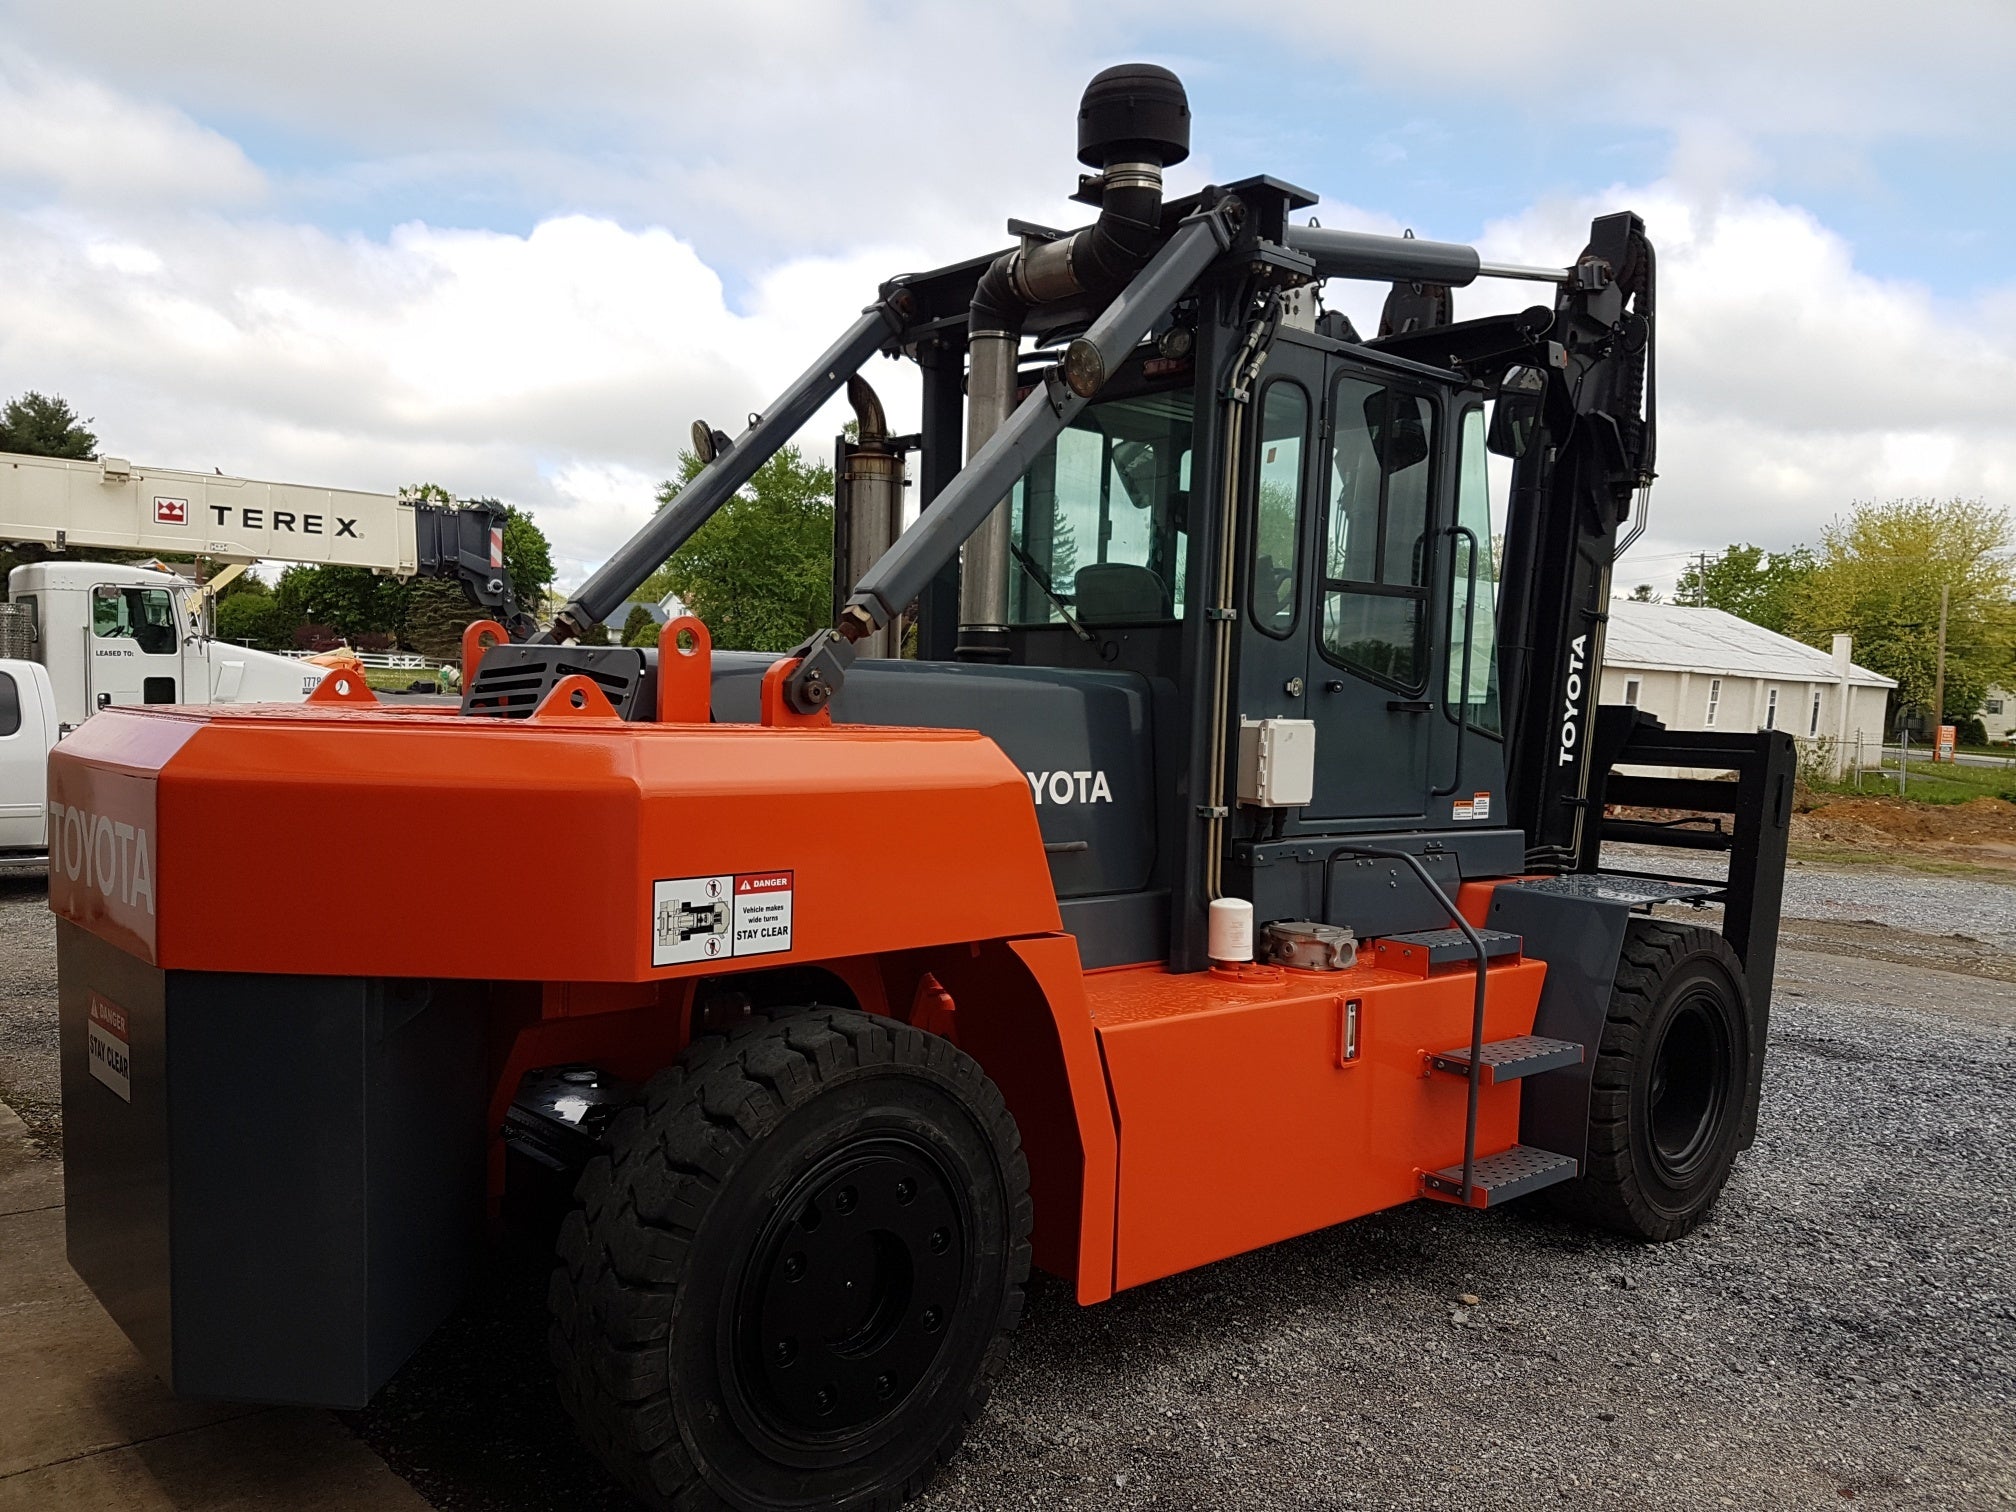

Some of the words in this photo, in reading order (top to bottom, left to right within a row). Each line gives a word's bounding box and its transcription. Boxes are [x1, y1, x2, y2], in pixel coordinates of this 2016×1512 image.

[210, 504, 358, 538] TEREX
[1558, 634, 1587, 767] TOYOTA
[49, 800, 154, 916] TOYOTA
[753, 877, 788, 888] DANGER
[742, 905, 764, 914] Vehicle
[765, 904, 784, 912] makes
[747, 915, 762, 923] wide
[736, 928, 759, 940] STAY
[760, 925, 789, 938] CLEAR
[99, 1004, 126, 1032] DANGER
[89, 1033, 106, 1062] STAY
[106, 1045, 129, 1080] CLEAR
